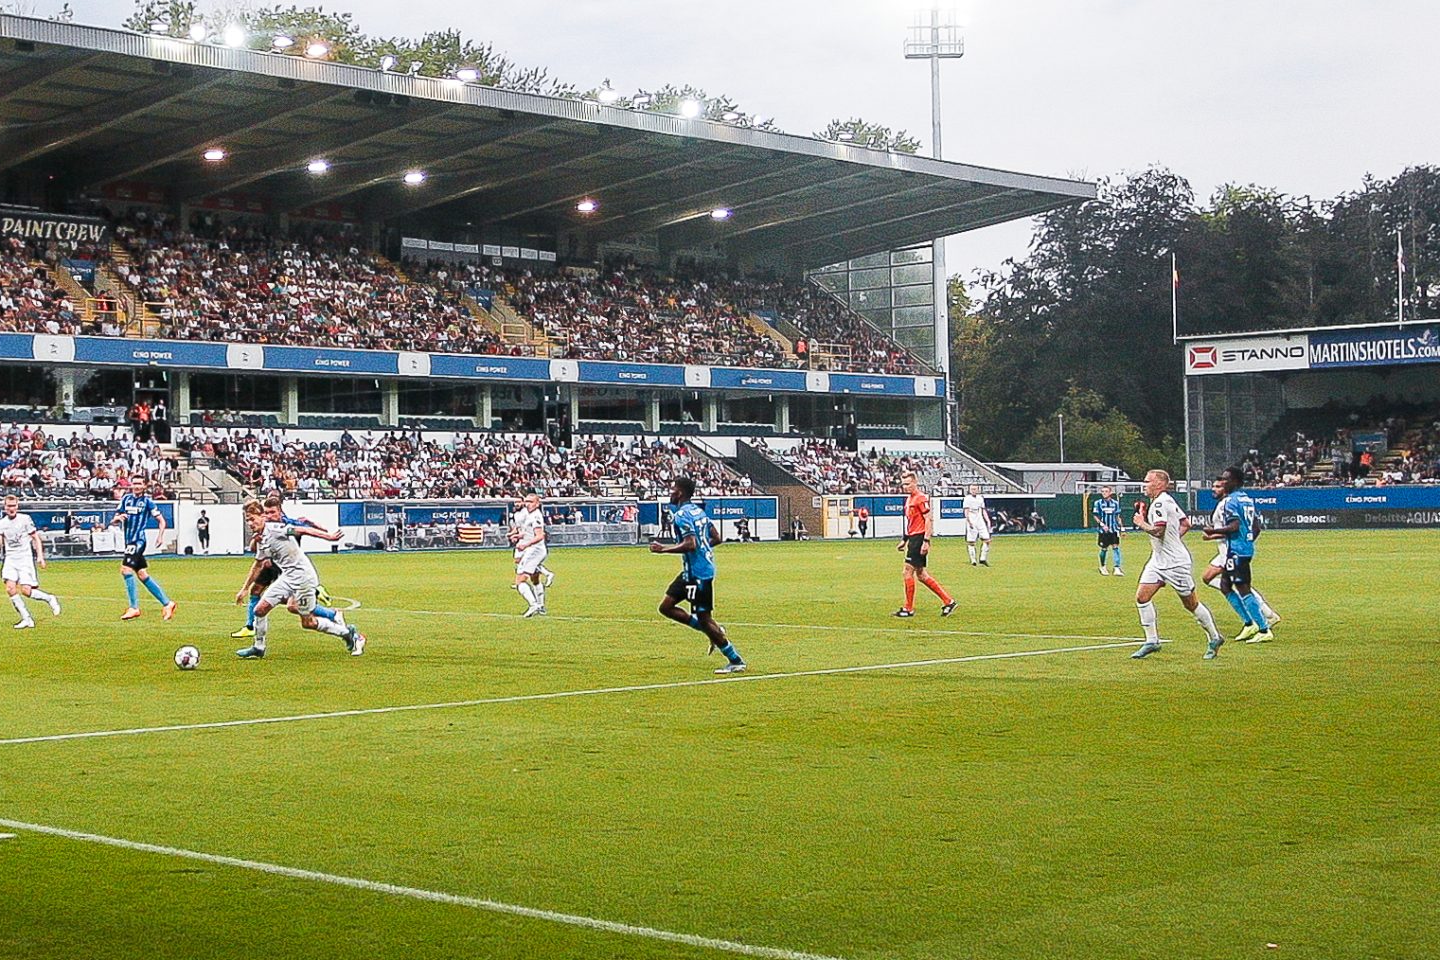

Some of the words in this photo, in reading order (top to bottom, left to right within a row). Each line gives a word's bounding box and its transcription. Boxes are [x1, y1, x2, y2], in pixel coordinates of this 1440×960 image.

[1, 217, 107, 242] PAINTCREW
[132, 351, 149, 359] KING
[150, 351, 173, 360] POWER
[1222, 346, 1304, 362] STANNO
[50, 515, 66, 524] KIN
[685, 584, 698, 600] 77
